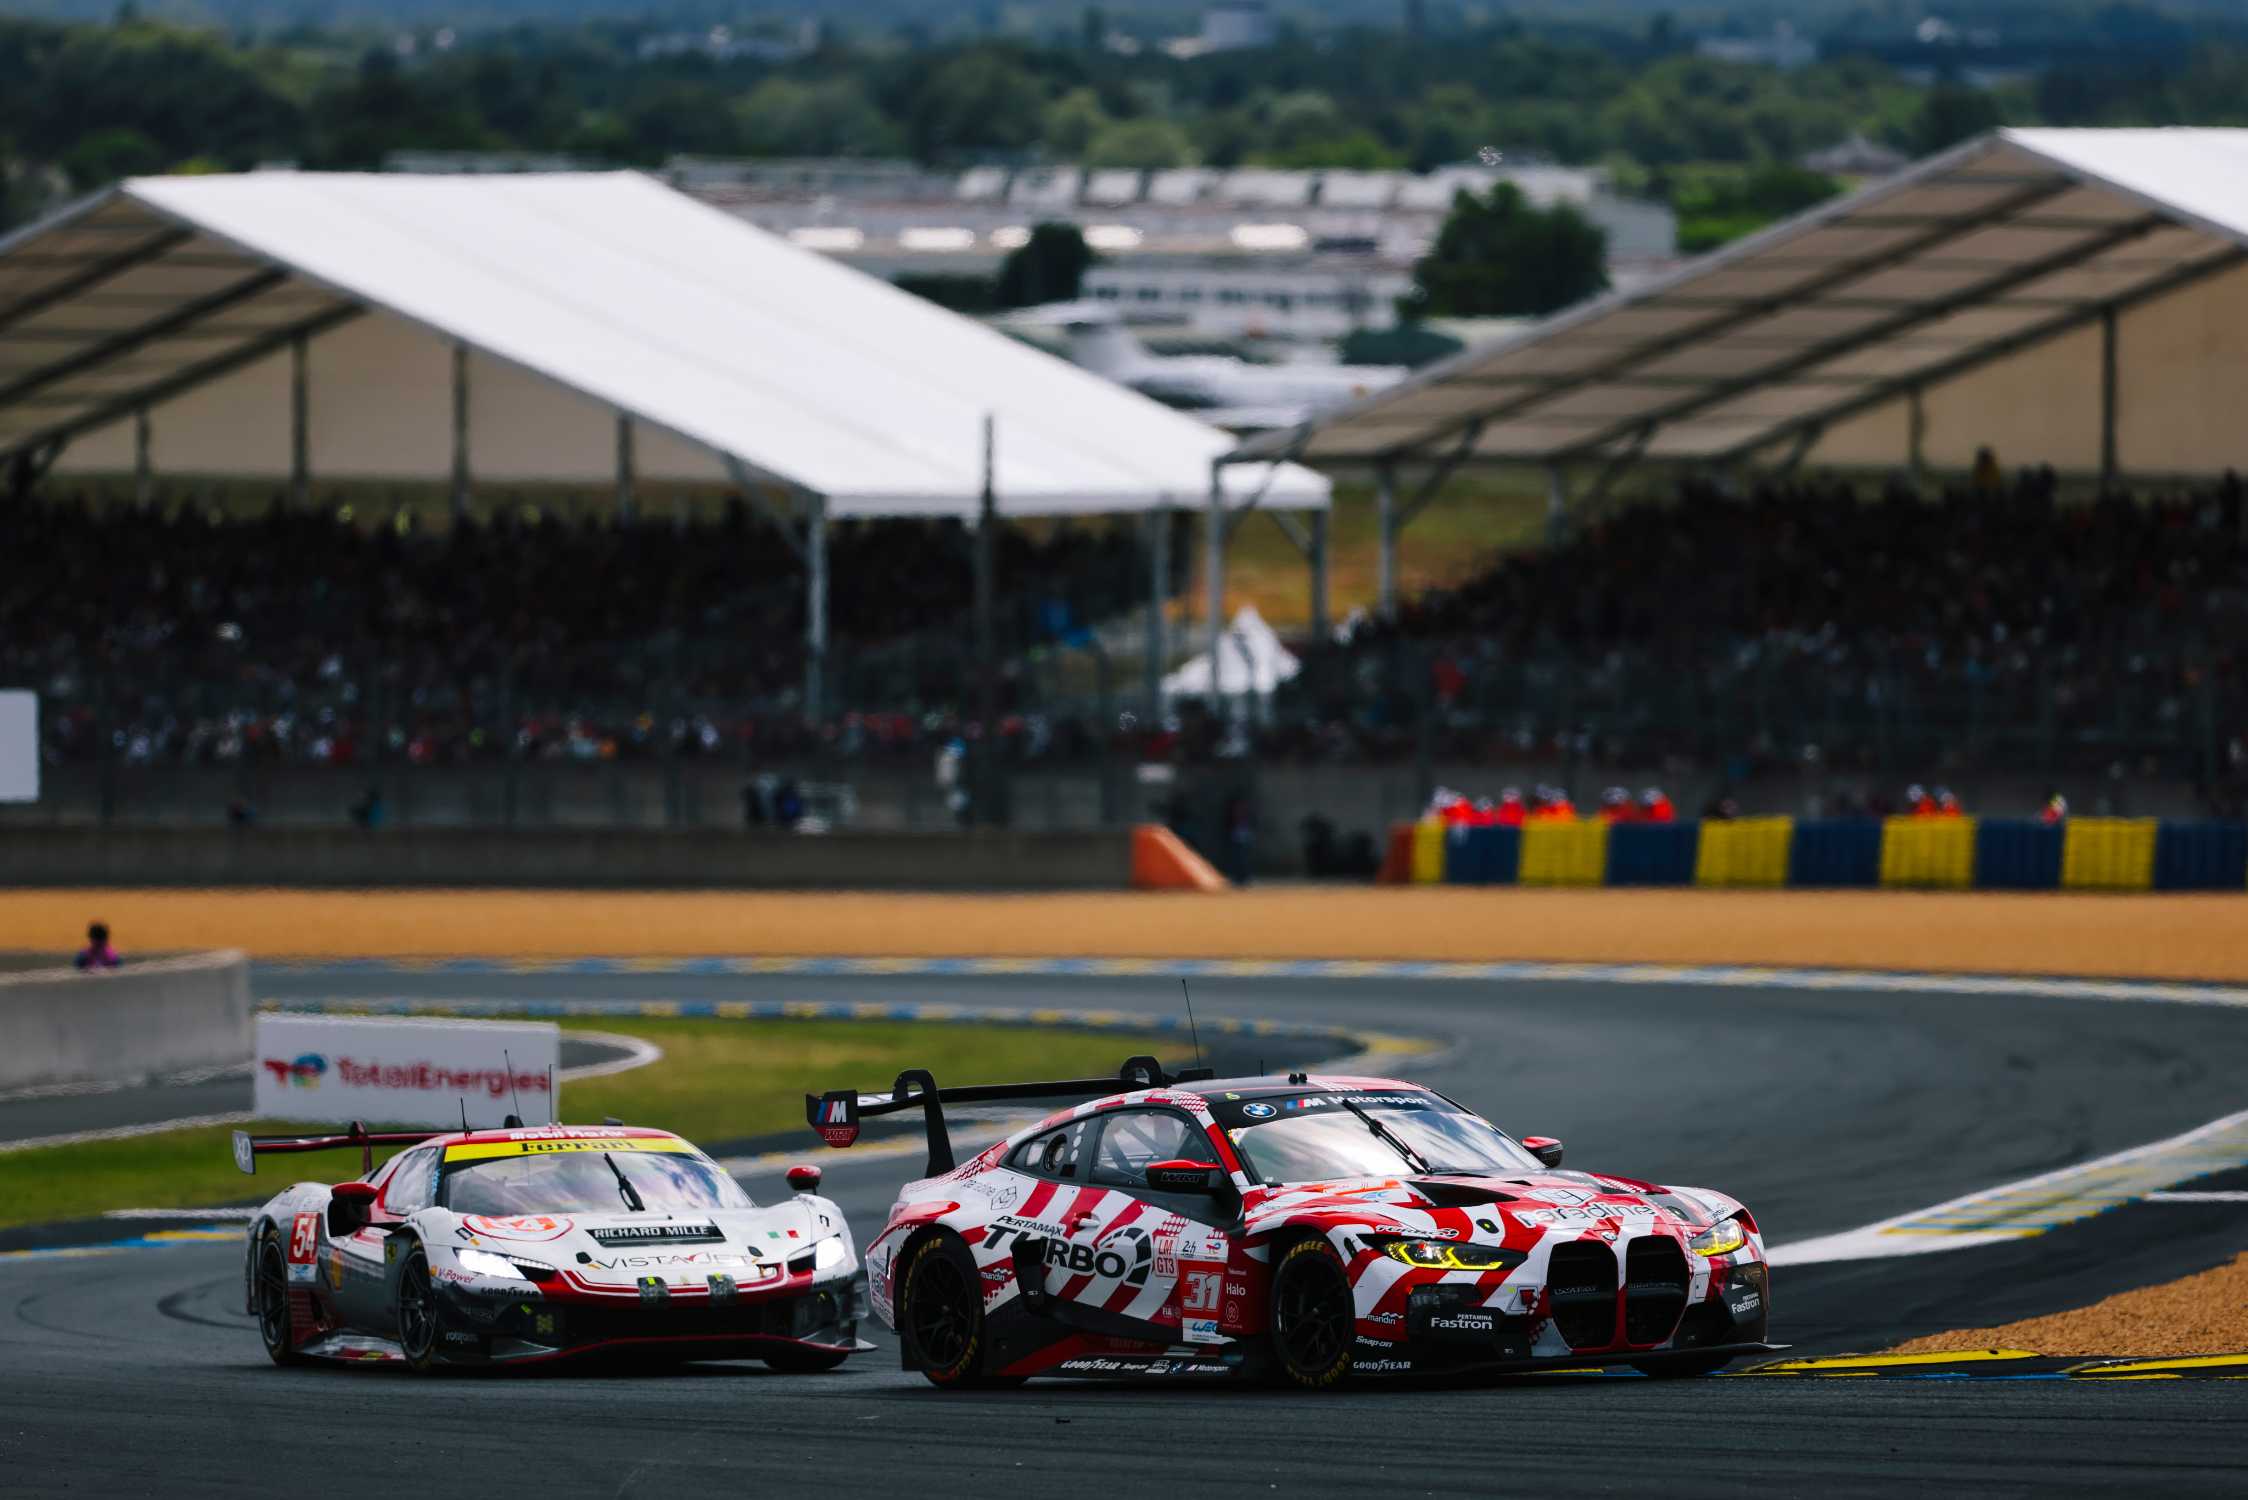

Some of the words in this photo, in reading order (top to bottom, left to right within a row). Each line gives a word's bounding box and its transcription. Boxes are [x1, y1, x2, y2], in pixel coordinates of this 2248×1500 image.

[337, 1056, 549, 1098] TotalEnergies
[1328, 1095, 1432, 1106] Motorsport
[521, 1140, 638, 1152] Ferrari
[594, 1227, 658, 1239] RICHARD
[664, 1226, 710, 1236] MILLE
[996, 1215, 1063, 1236] PERTAMAX
[293, 1217, 317, 1259] 54
[1159, 1240, 1173, 1255] LM
[1157, 1257, 1175, 1274] GT3
[438, 1267, 475, 1284] V-Power
[1184, 1271, 1223, 1312] 31
[1226, 1282, 1246, 1296] Halo
[1731, 1298, 1760, 1313] Fastron
[1431, 1317, 1493, 1330] Fastron
[1355, 1335, 1393, 1347] Snap-on
[1060, 1359, 1121, 1370] GOODYEAR
[1353, 1359, 1412, 1371] GOODYEAR
